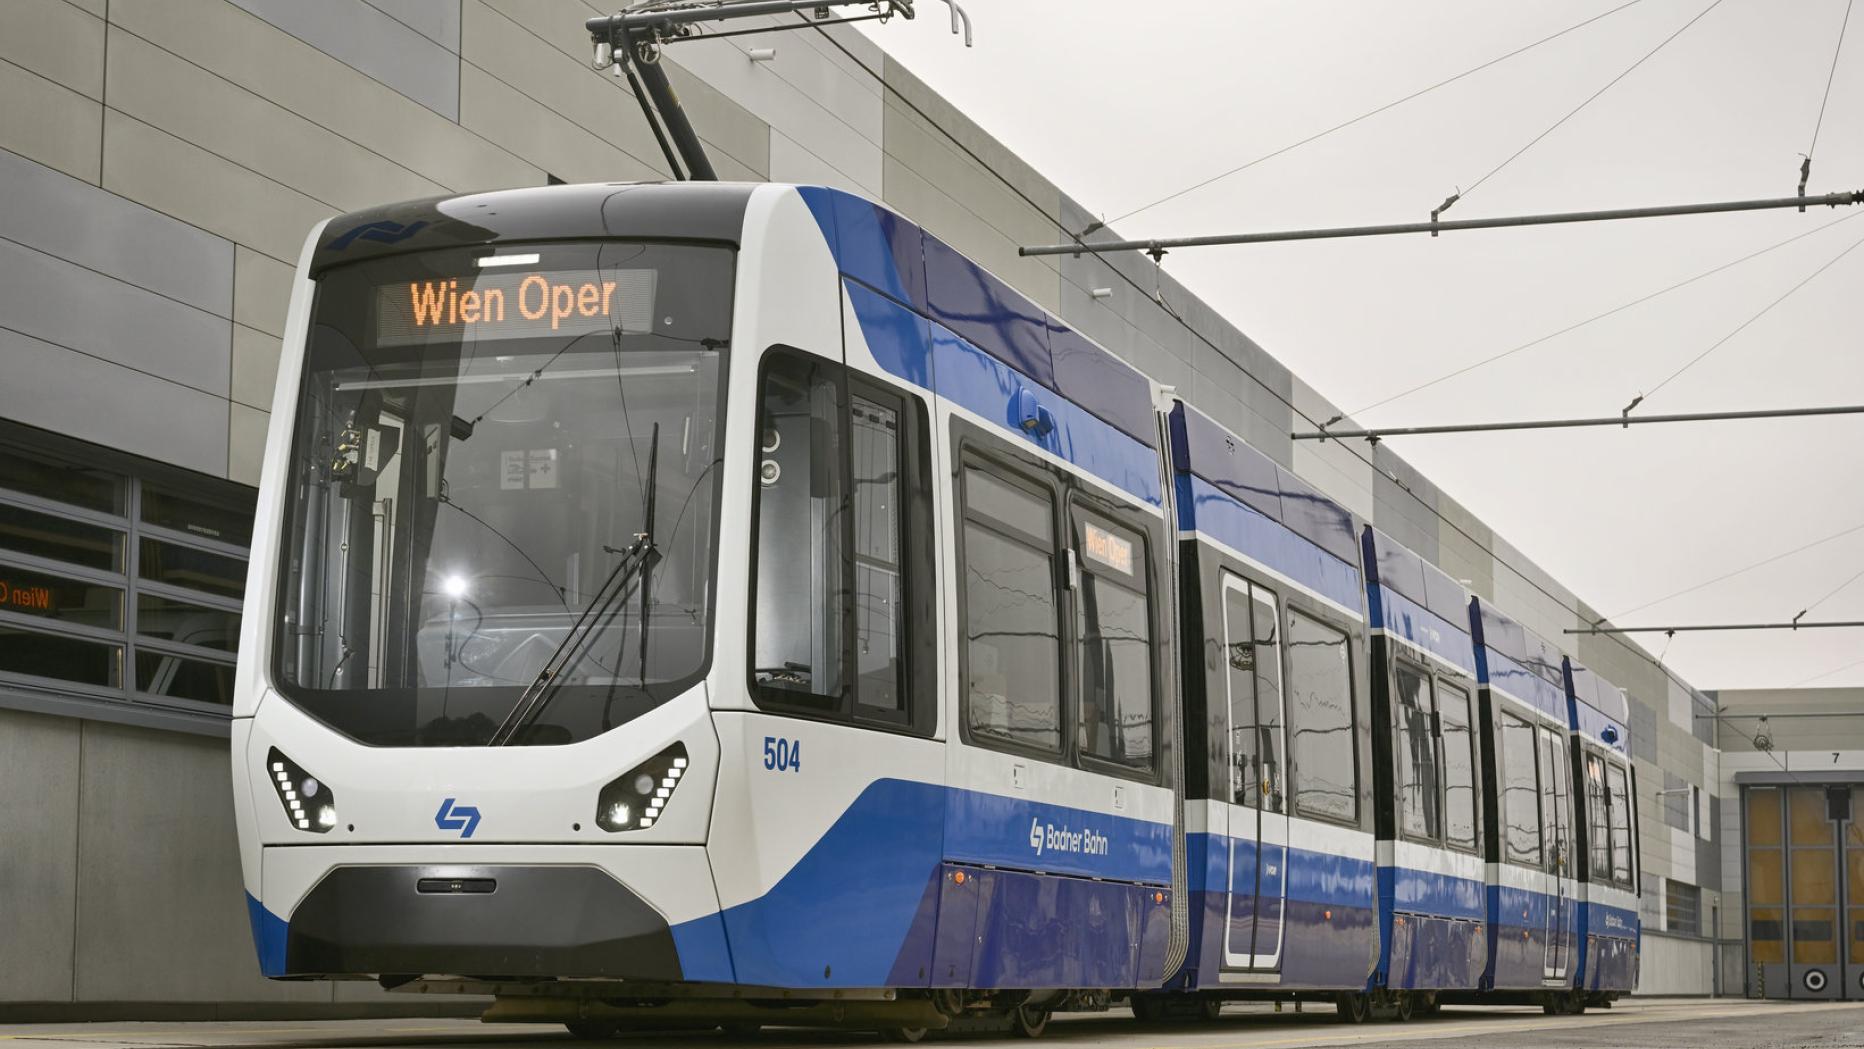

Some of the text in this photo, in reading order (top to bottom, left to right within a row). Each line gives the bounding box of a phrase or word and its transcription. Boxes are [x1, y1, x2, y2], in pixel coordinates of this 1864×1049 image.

[410, 274, 617, 330] Wien Oper
[764, 736, 800, 772] 504
[1831, 752, 1840, 764] 7
[1046, 824, 1108, 855] Badner Bahn
